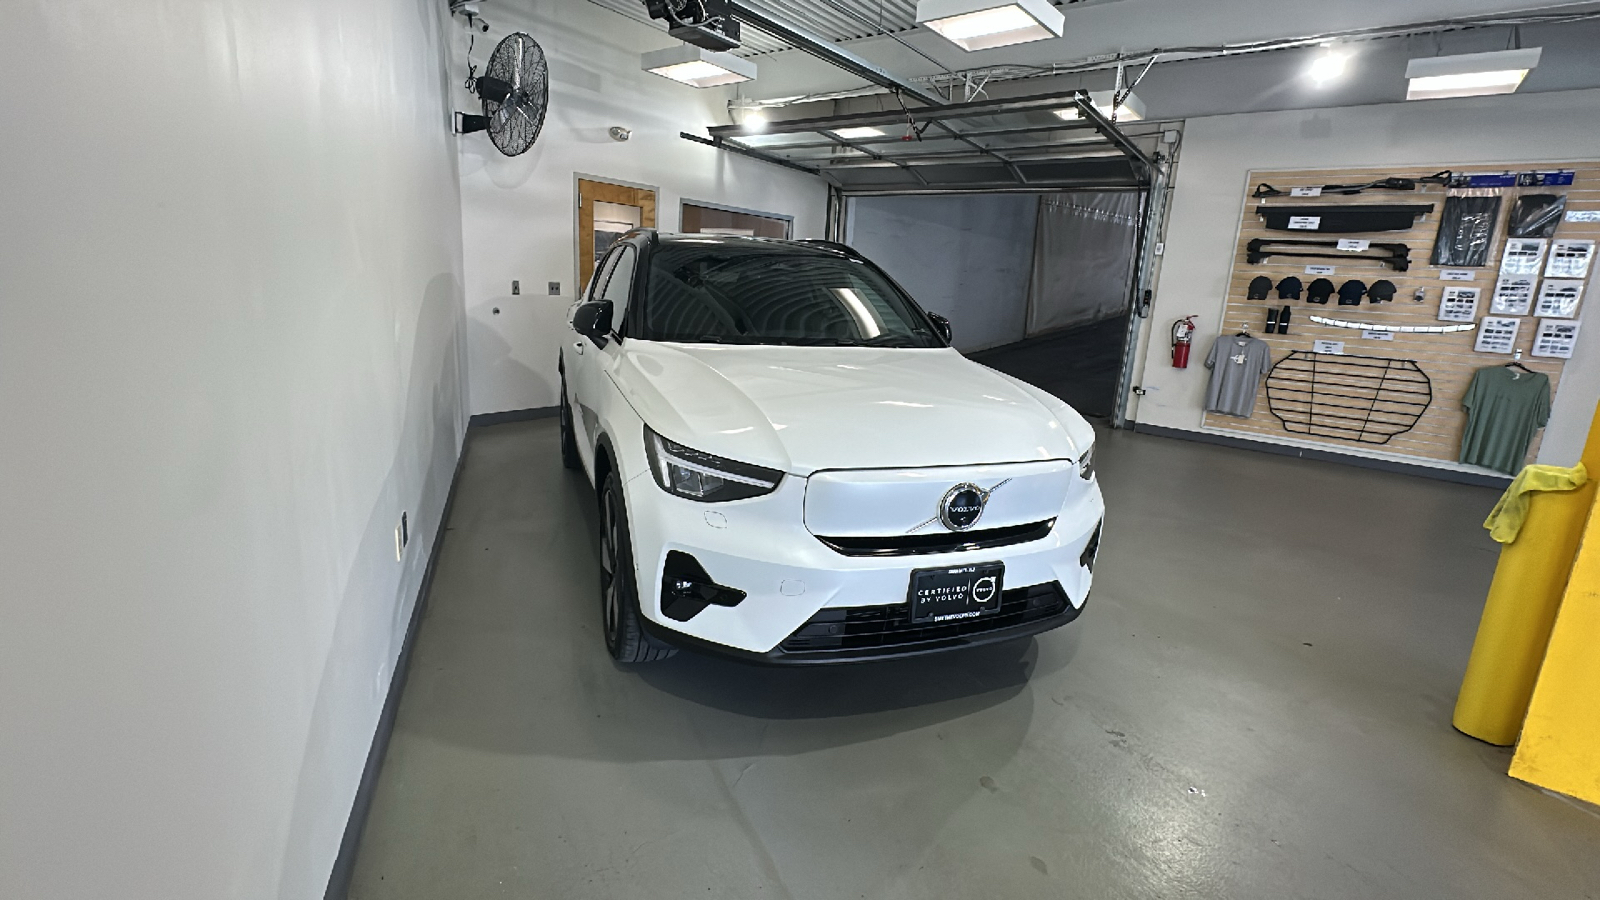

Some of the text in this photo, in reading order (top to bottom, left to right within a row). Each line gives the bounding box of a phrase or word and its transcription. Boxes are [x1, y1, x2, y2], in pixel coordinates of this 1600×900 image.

[950, 505, 980, 513] VOLVO
[918, 585, 967, 596] CERTIFIED
[920, 593, 964, 604] BY VOLVO
